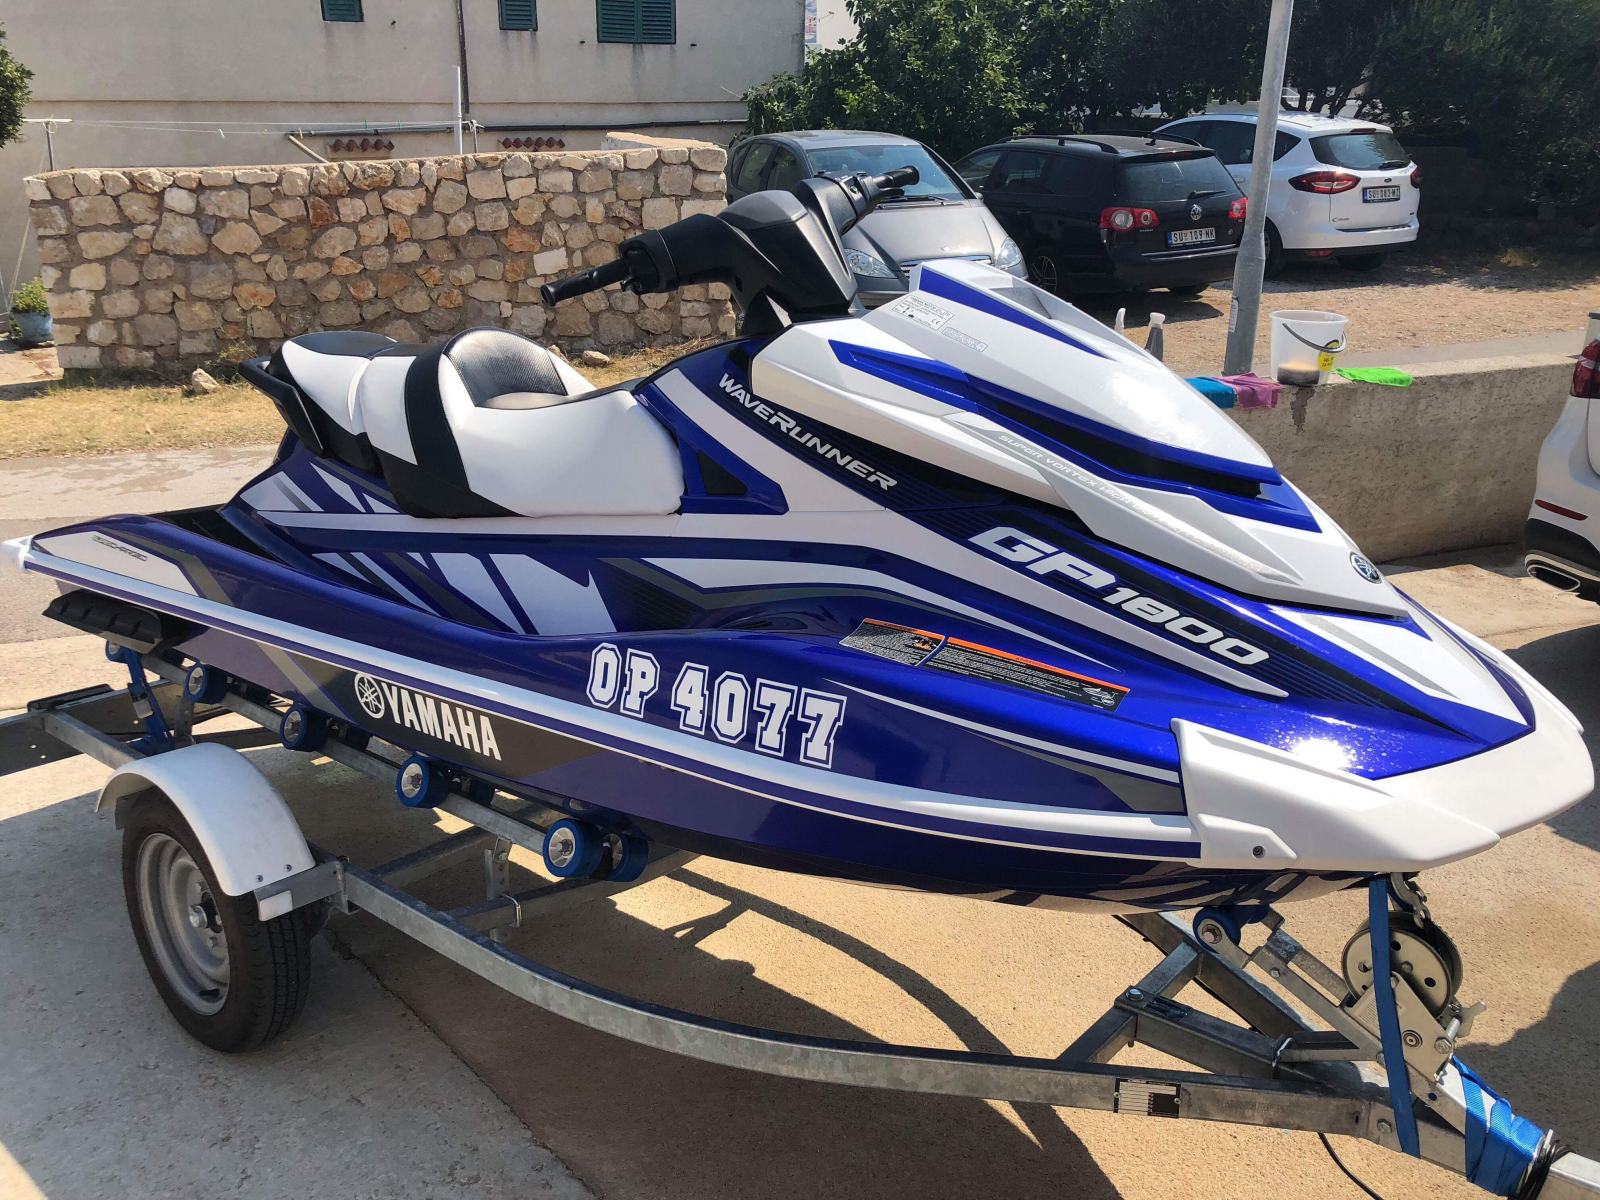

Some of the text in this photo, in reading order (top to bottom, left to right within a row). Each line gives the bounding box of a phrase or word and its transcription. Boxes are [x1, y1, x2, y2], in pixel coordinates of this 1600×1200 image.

[1173, 231, 1184, 242] SU
[719, 373, 898, 490] WAVERUNNER
[999, 435, 1044, 458] SUPER
[1046, 458, 1097, 487] VORTEX
[381, 682, 502, 761] YAMAHA
[586, 642, 660, 719] OP
[671, 661, 848, 769] 4077
